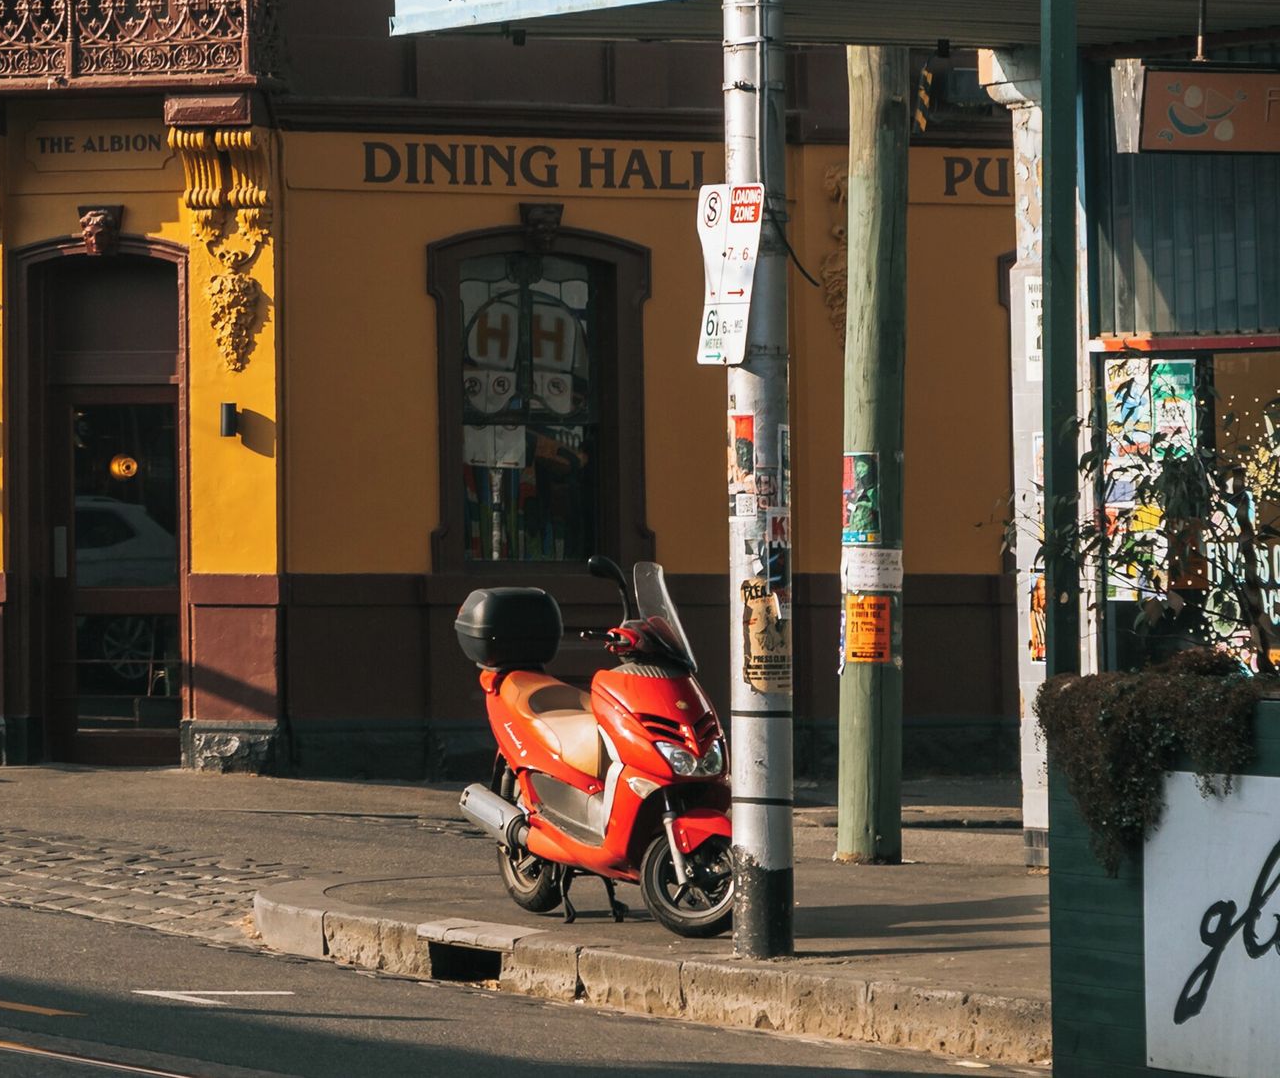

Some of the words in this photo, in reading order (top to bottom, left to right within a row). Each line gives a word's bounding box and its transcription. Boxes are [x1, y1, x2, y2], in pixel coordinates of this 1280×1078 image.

[36, 136, 76, 154] THE
[83, 134, 161, 153] ALBION
[362, 141, 559, 189] DINING
[731, 187, 762, 205] LOADING
[733, 205, 756, 222] ZONE
[1173, 839, 1280, 1026] gl
